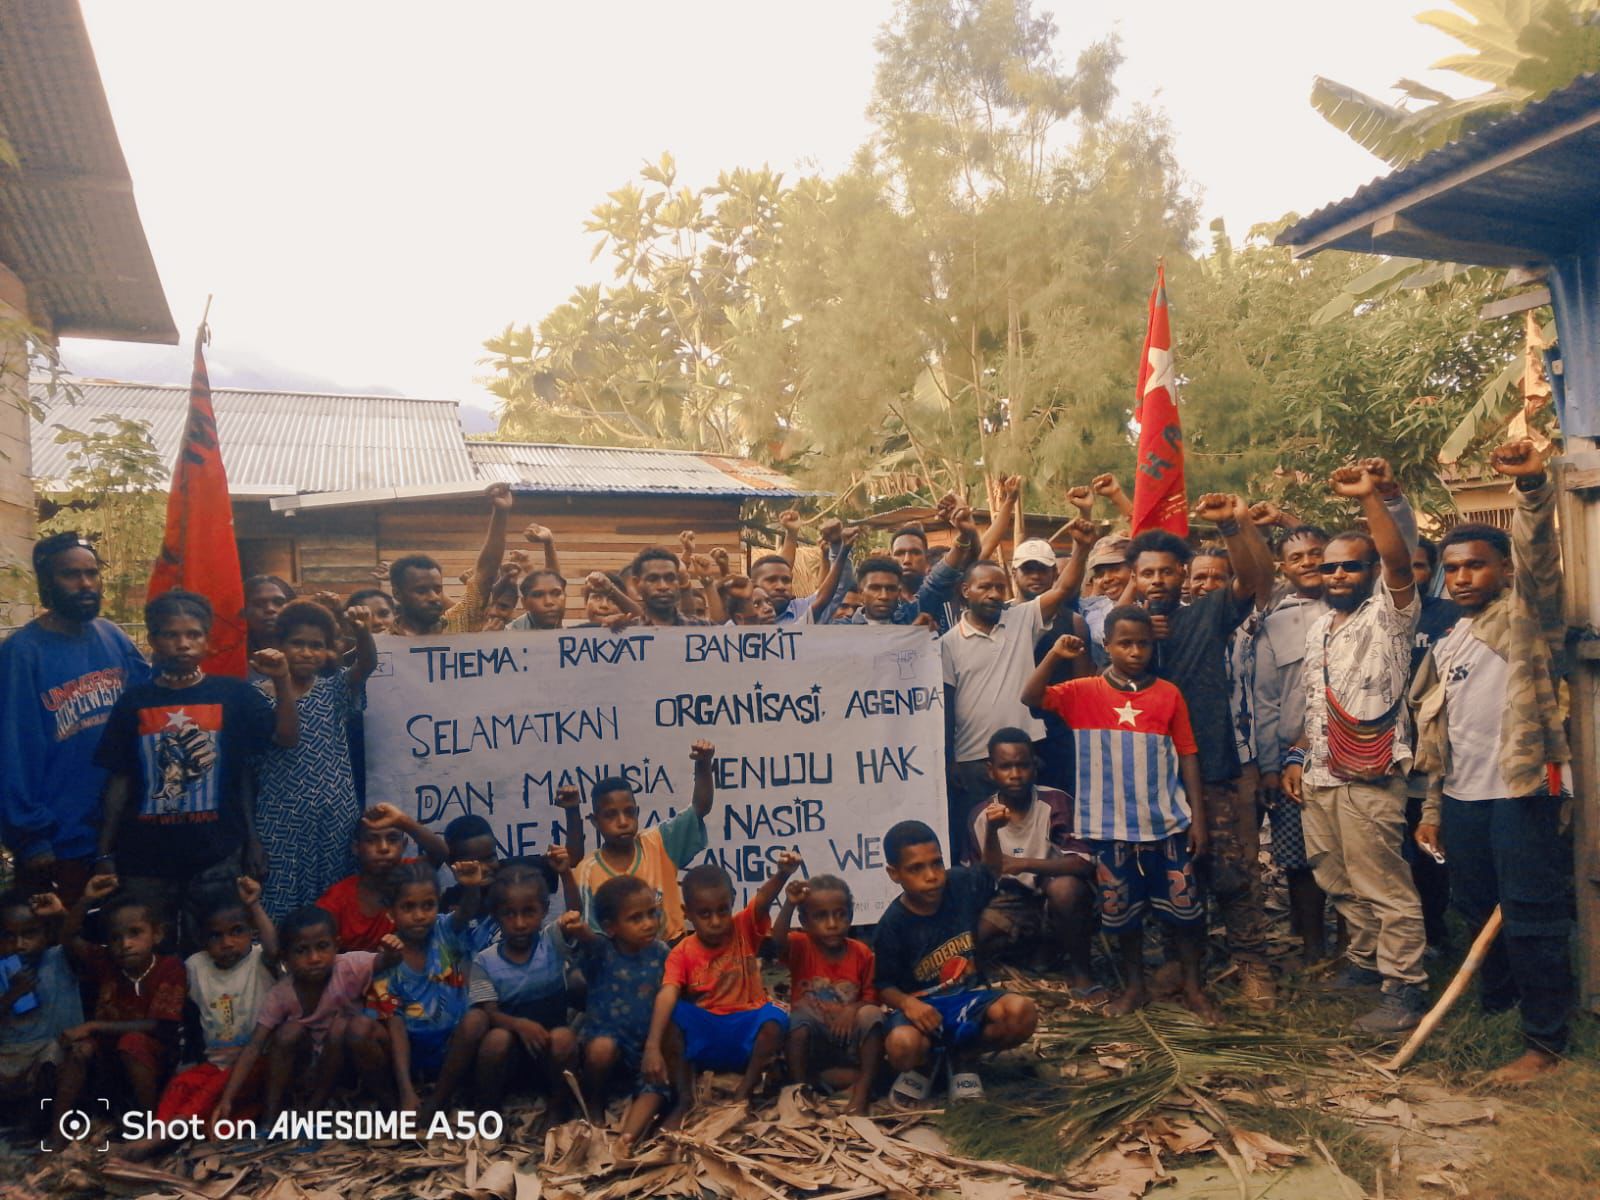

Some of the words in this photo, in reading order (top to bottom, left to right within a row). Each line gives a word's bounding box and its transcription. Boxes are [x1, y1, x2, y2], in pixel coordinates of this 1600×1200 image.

[410, 647, 528, 682] THEMA:
[559, 635, 654, 668] RAKYAT
[406, 706, 618, 758] SELAMATKAN
[415, 781, 493, 824] DAN
[856, 745, 924, 784] HAK
